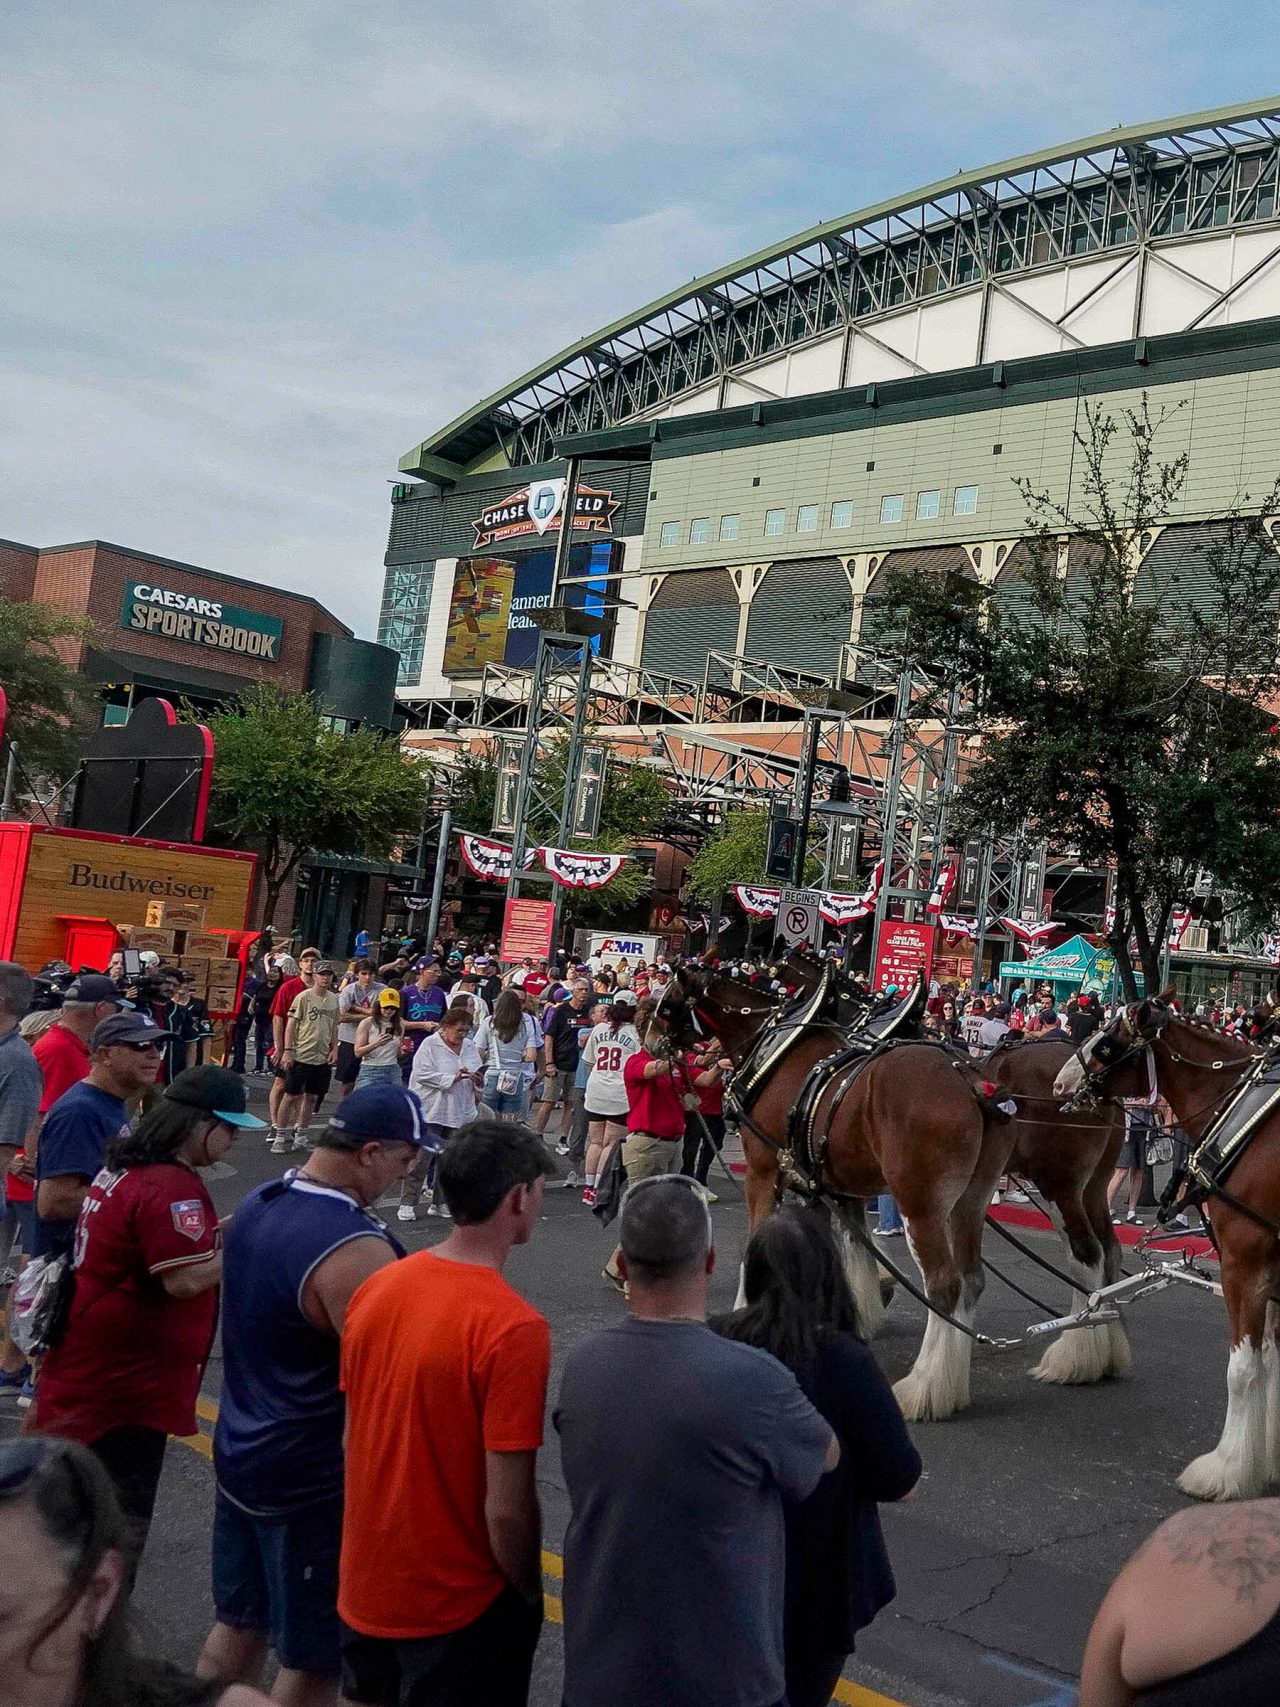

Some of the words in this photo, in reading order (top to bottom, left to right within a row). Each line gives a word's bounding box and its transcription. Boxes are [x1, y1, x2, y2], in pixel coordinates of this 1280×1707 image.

[483, 504, 525, 527] CHASE
[133, 585, 223, 618] CAESARS
[510, 594, 550, 610] anner
[130, 603, 277, 659] SPORTSBOOK
[71, 863, 215, 901] Budweiser
[784, 891, 816, 905] BEGINS
[601, 939, 644, 955] AMR
[595, 1032, 633, 1047] ARENADO
[966, 1029, 979, 1044] 13
[597, 1046, 622, 1071] 28
